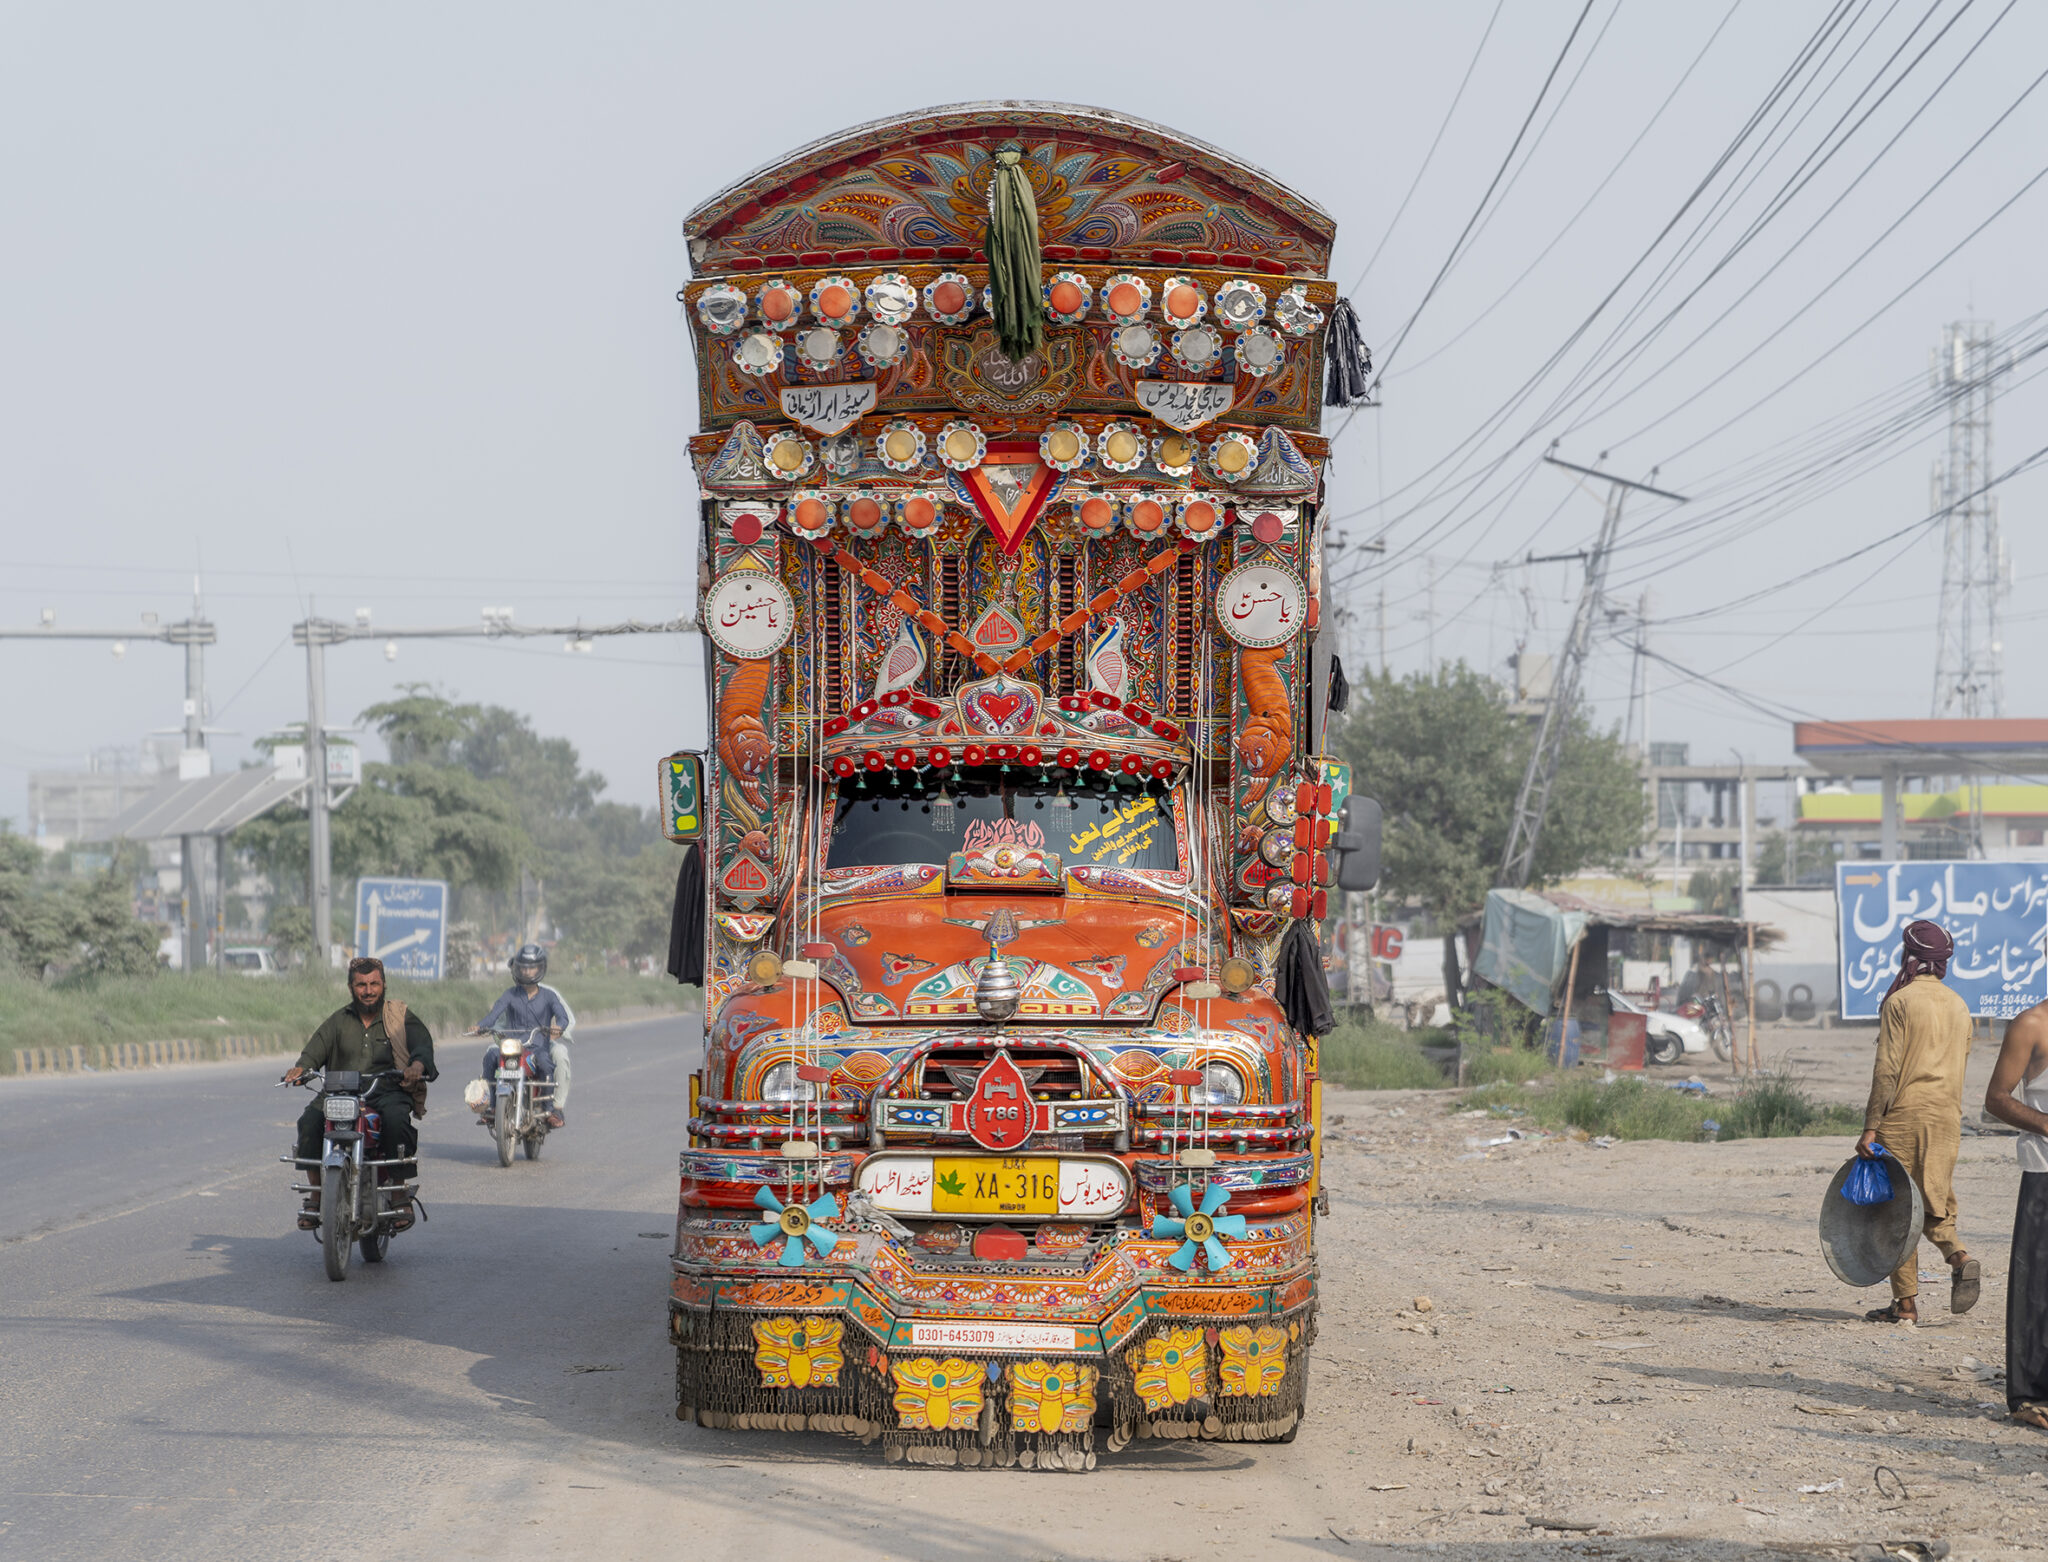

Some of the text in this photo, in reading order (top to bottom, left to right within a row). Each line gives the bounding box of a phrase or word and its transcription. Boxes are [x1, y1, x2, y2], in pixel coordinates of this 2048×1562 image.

[767, 605, 779, 628] یا
[1278, 597, 1292, 623] یا
[983, 1106, 1019, 1121] 786
[918, 1328, 995, 1343] 0301-6453079
